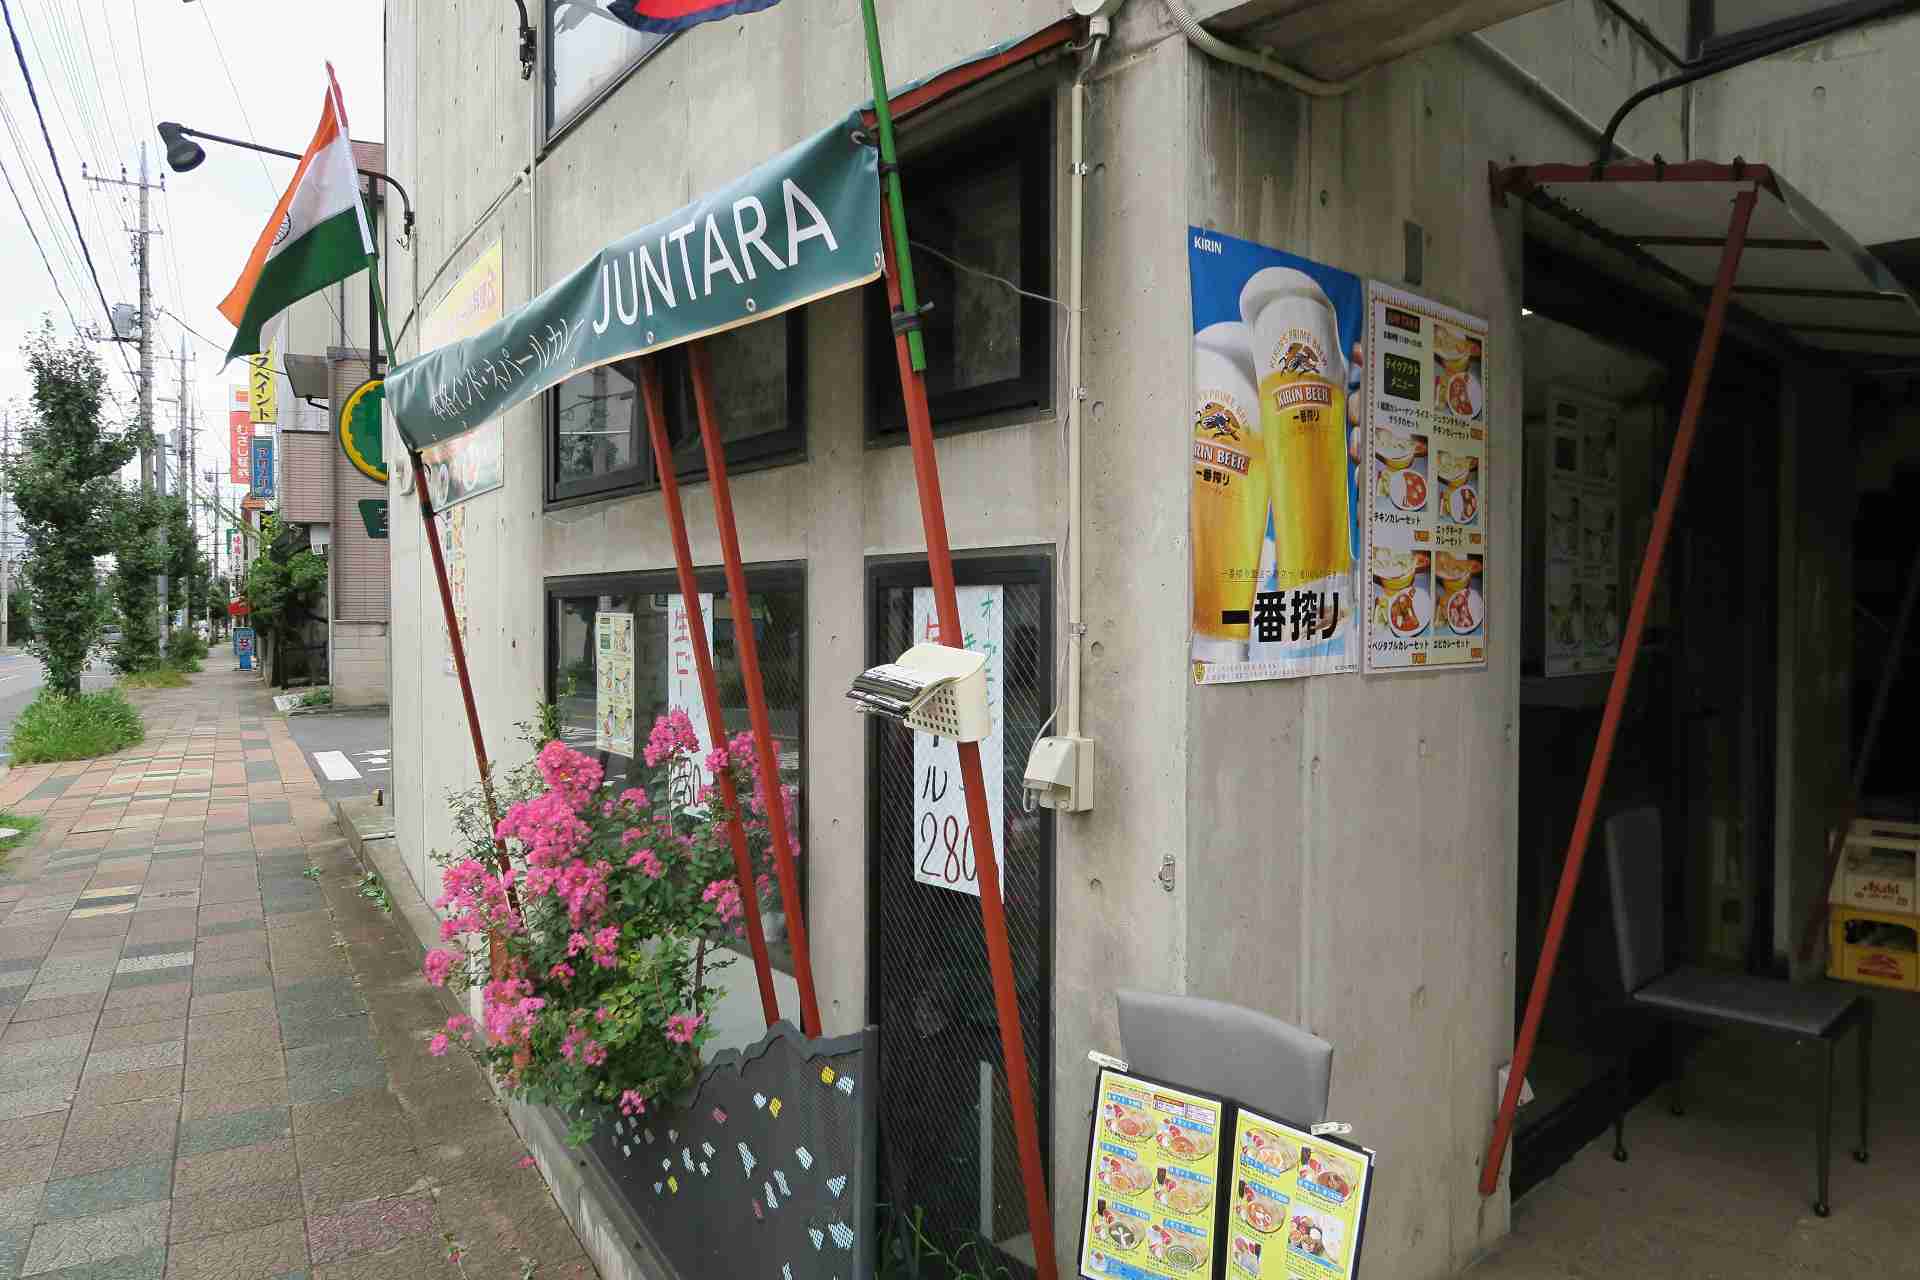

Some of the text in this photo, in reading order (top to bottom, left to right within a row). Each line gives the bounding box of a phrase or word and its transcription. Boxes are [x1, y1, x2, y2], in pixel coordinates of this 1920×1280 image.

[593, 178, 838, 334] JUNTARA
[1194, 235, 1222, 255] KIRIN
[1216, 449, 1245, 470] BEER
[1222, 590, 1339, 642] 一番搾り
[921, 812, 977, 883] 280
